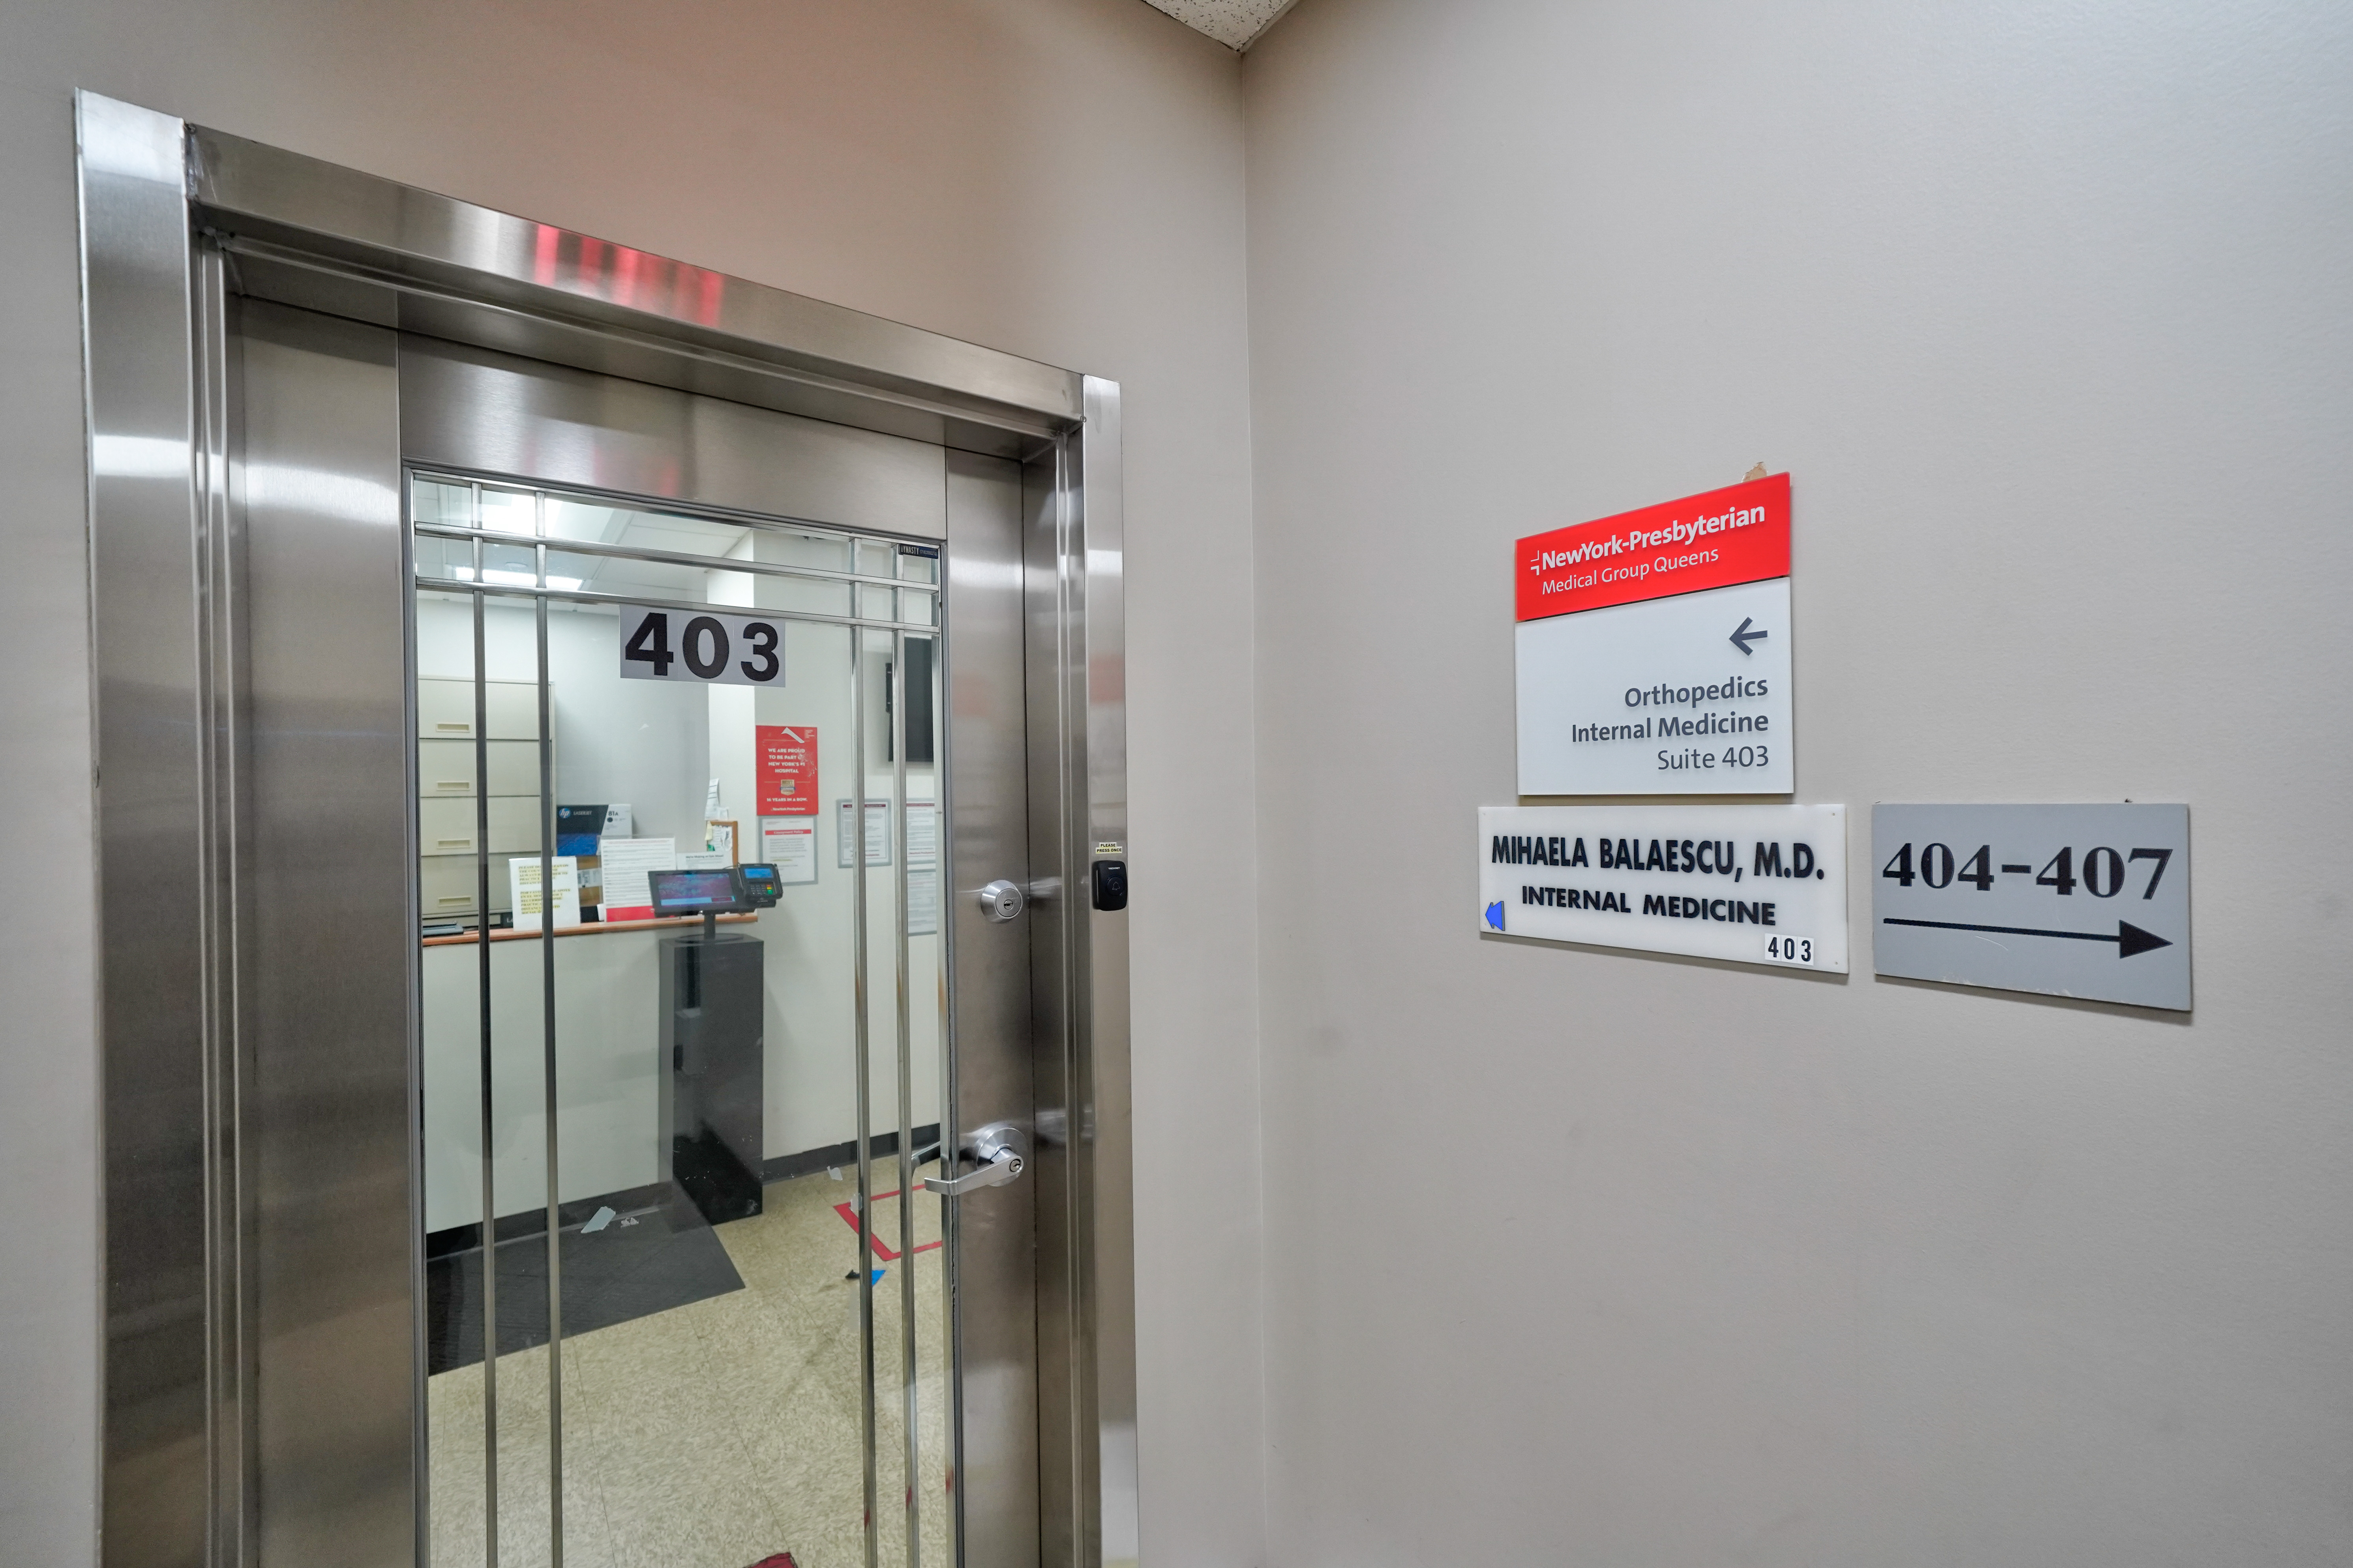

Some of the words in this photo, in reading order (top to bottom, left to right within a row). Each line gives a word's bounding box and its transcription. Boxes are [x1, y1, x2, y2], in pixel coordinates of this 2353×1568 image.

[901, 545, 919, 554] DYNASTY
[1542, 506, 1765, 570] NewYork-Presbyterian
[1542, 570, 1597, 595] Medical
[1601, 564, 1650, 582] Group
[1654, 549, 1719, 572] Queens
[625, 612, 779, 682] 403
[1625, 675, 1768, 709] Orthopedics
[1572, 717, 1651, 743] Internal
[1658, 711, 1768, 737] Medicine
[1658, 748, 1715, 770] Suite
[1722, 745, 1768, 767] 403
[560, 808, 570, 818] hp
[1492, 836, 1589, 868] MIHAELA
[1600, 838, 1743, 883] BALAESCU,
[1754, 842, 1824, 880] M.D.
[1882, 843, 2173, 900] 404-407
[1522, 885, 1631, 913] INTERNAL
[1642, 894, 1776, 926] MEDICINE
[1768, 937, 1811, 962] 403
